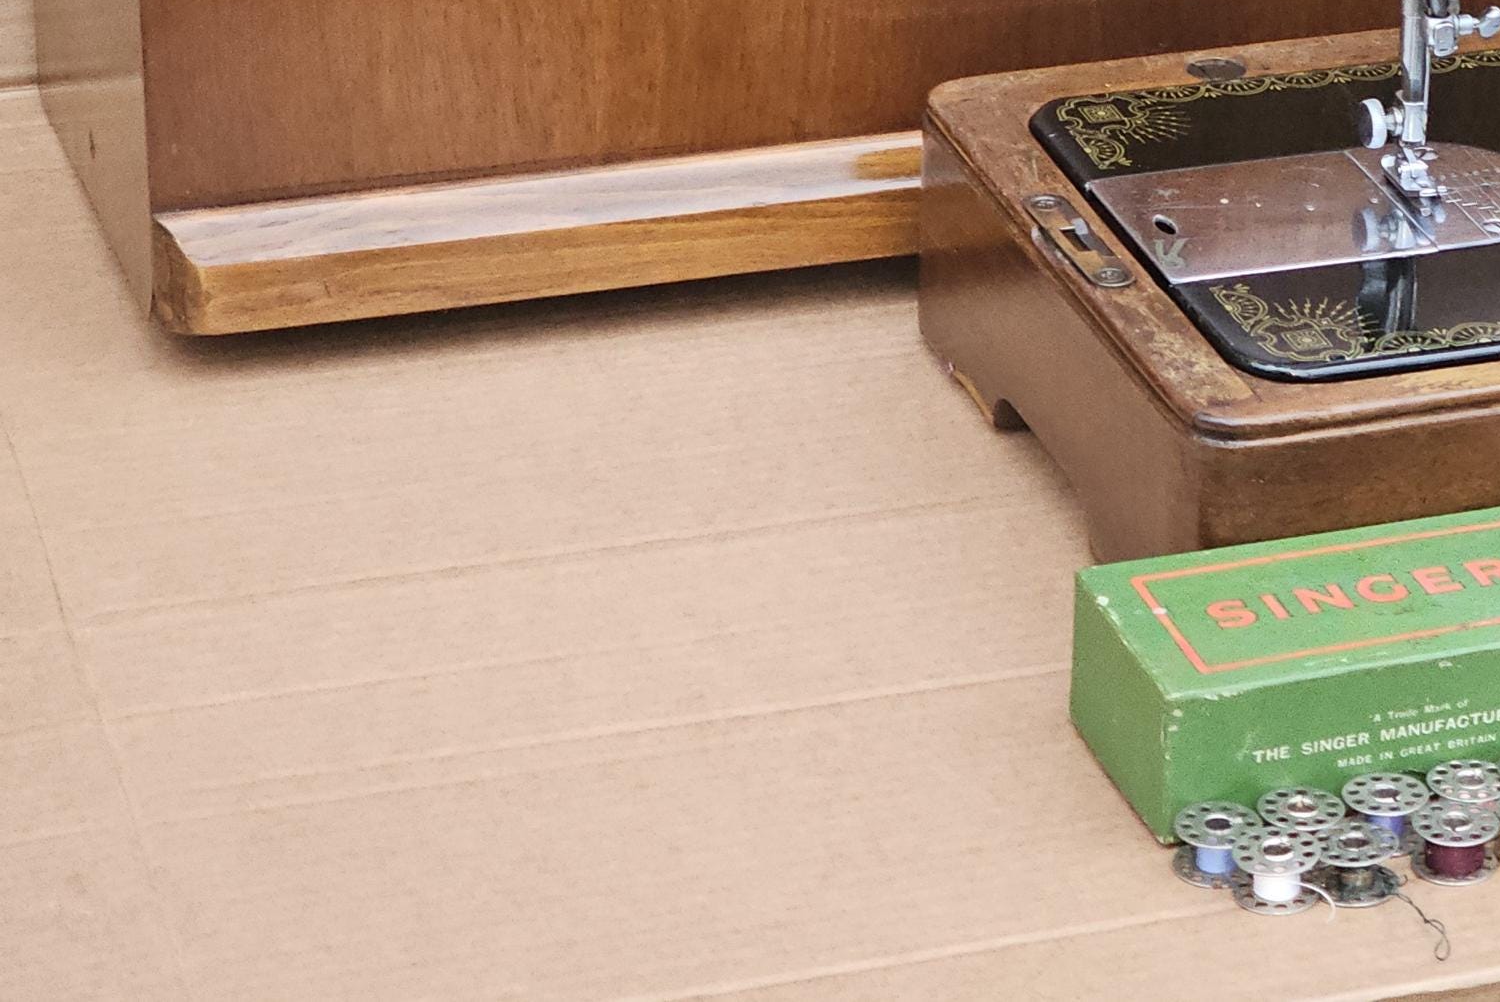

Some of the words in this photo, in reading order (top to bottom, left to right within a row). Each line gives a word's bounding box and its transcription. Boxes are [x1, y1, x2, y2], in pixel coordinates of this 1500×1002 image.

[1251, 745, 1291, 764] THE
[1301, 731, 1371, 756] SINGER
[1336, 753, 1373, 769] MADE
[1379, 749, 1394, 761] IN
[1399, 741, 1442, 759] GREAT
[1447, 732, 1499, 750] BRITAIN
